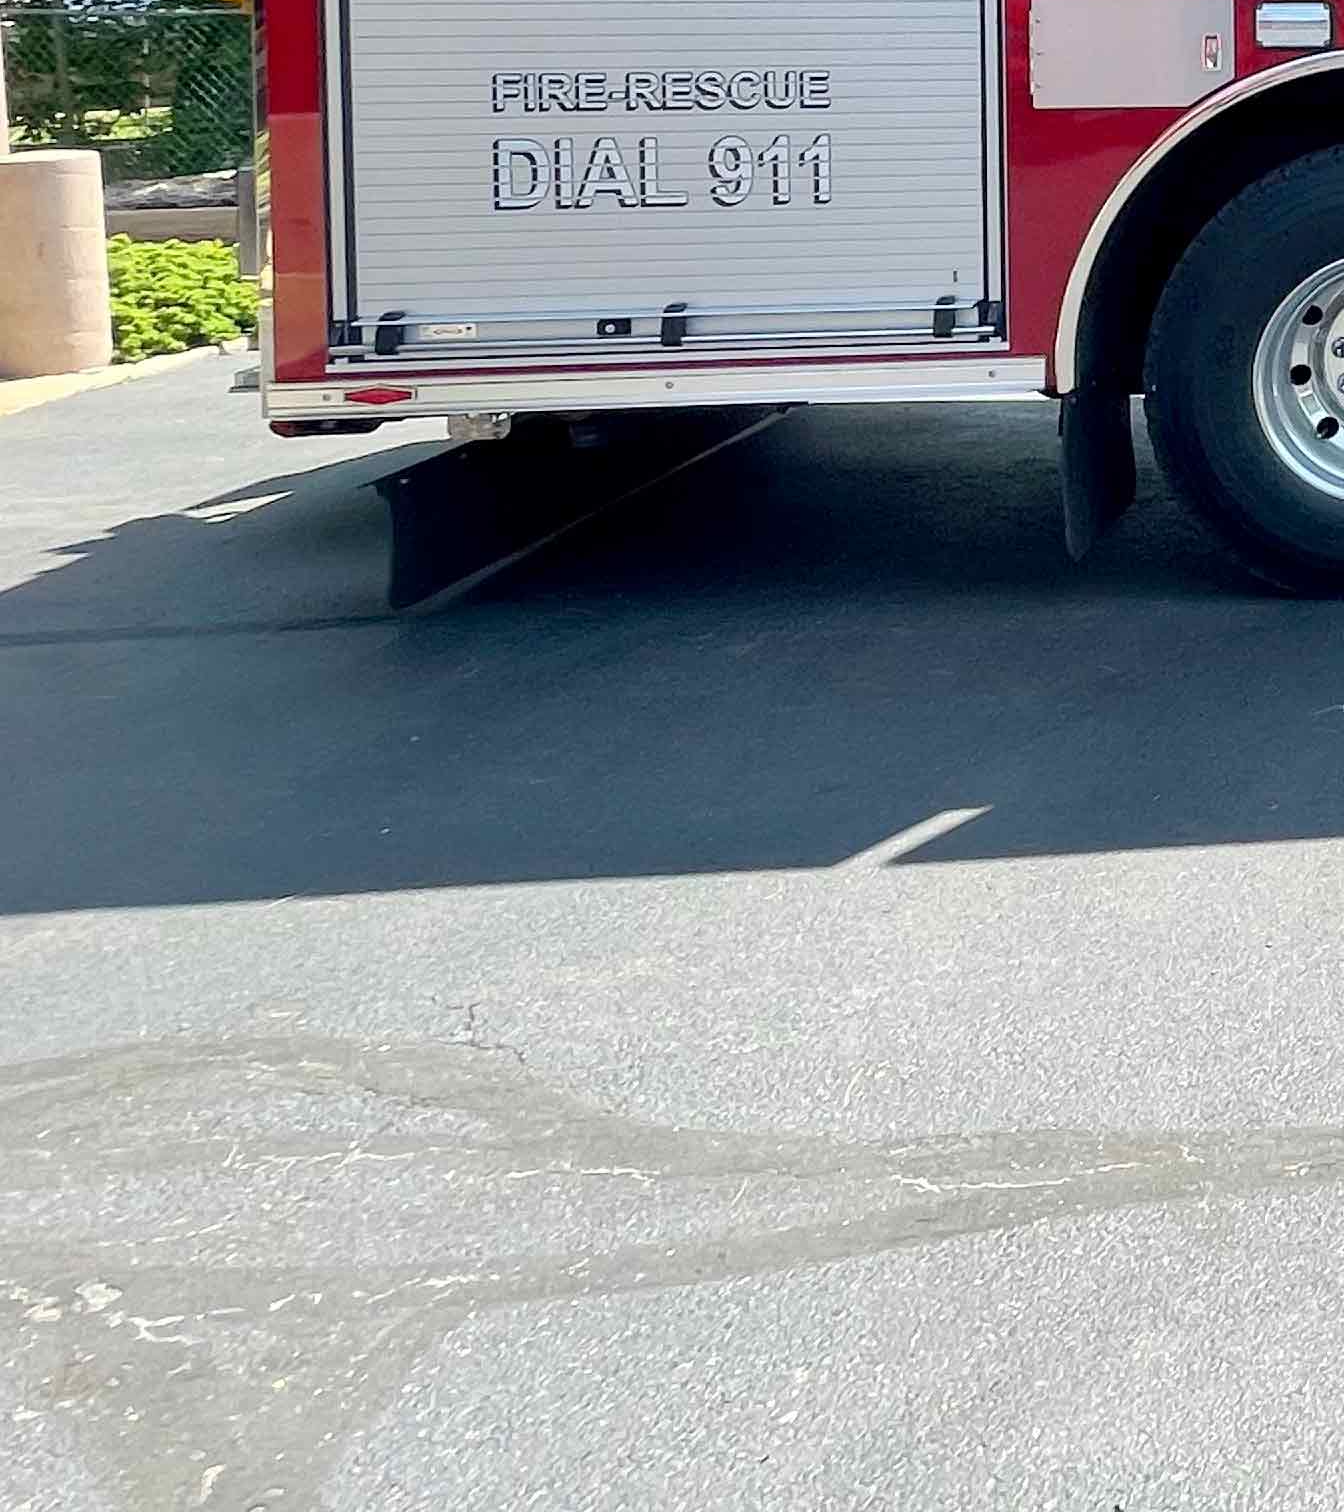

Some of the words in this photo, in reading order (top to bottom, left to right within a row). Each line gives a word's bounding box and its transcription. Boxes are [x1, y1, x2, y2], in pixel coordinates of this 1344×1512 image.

[492, 70, 832, 113] FIRE-RESCUE
[492, 136, 689, 211] DIAL
[708, 133, 832, 208] 911
